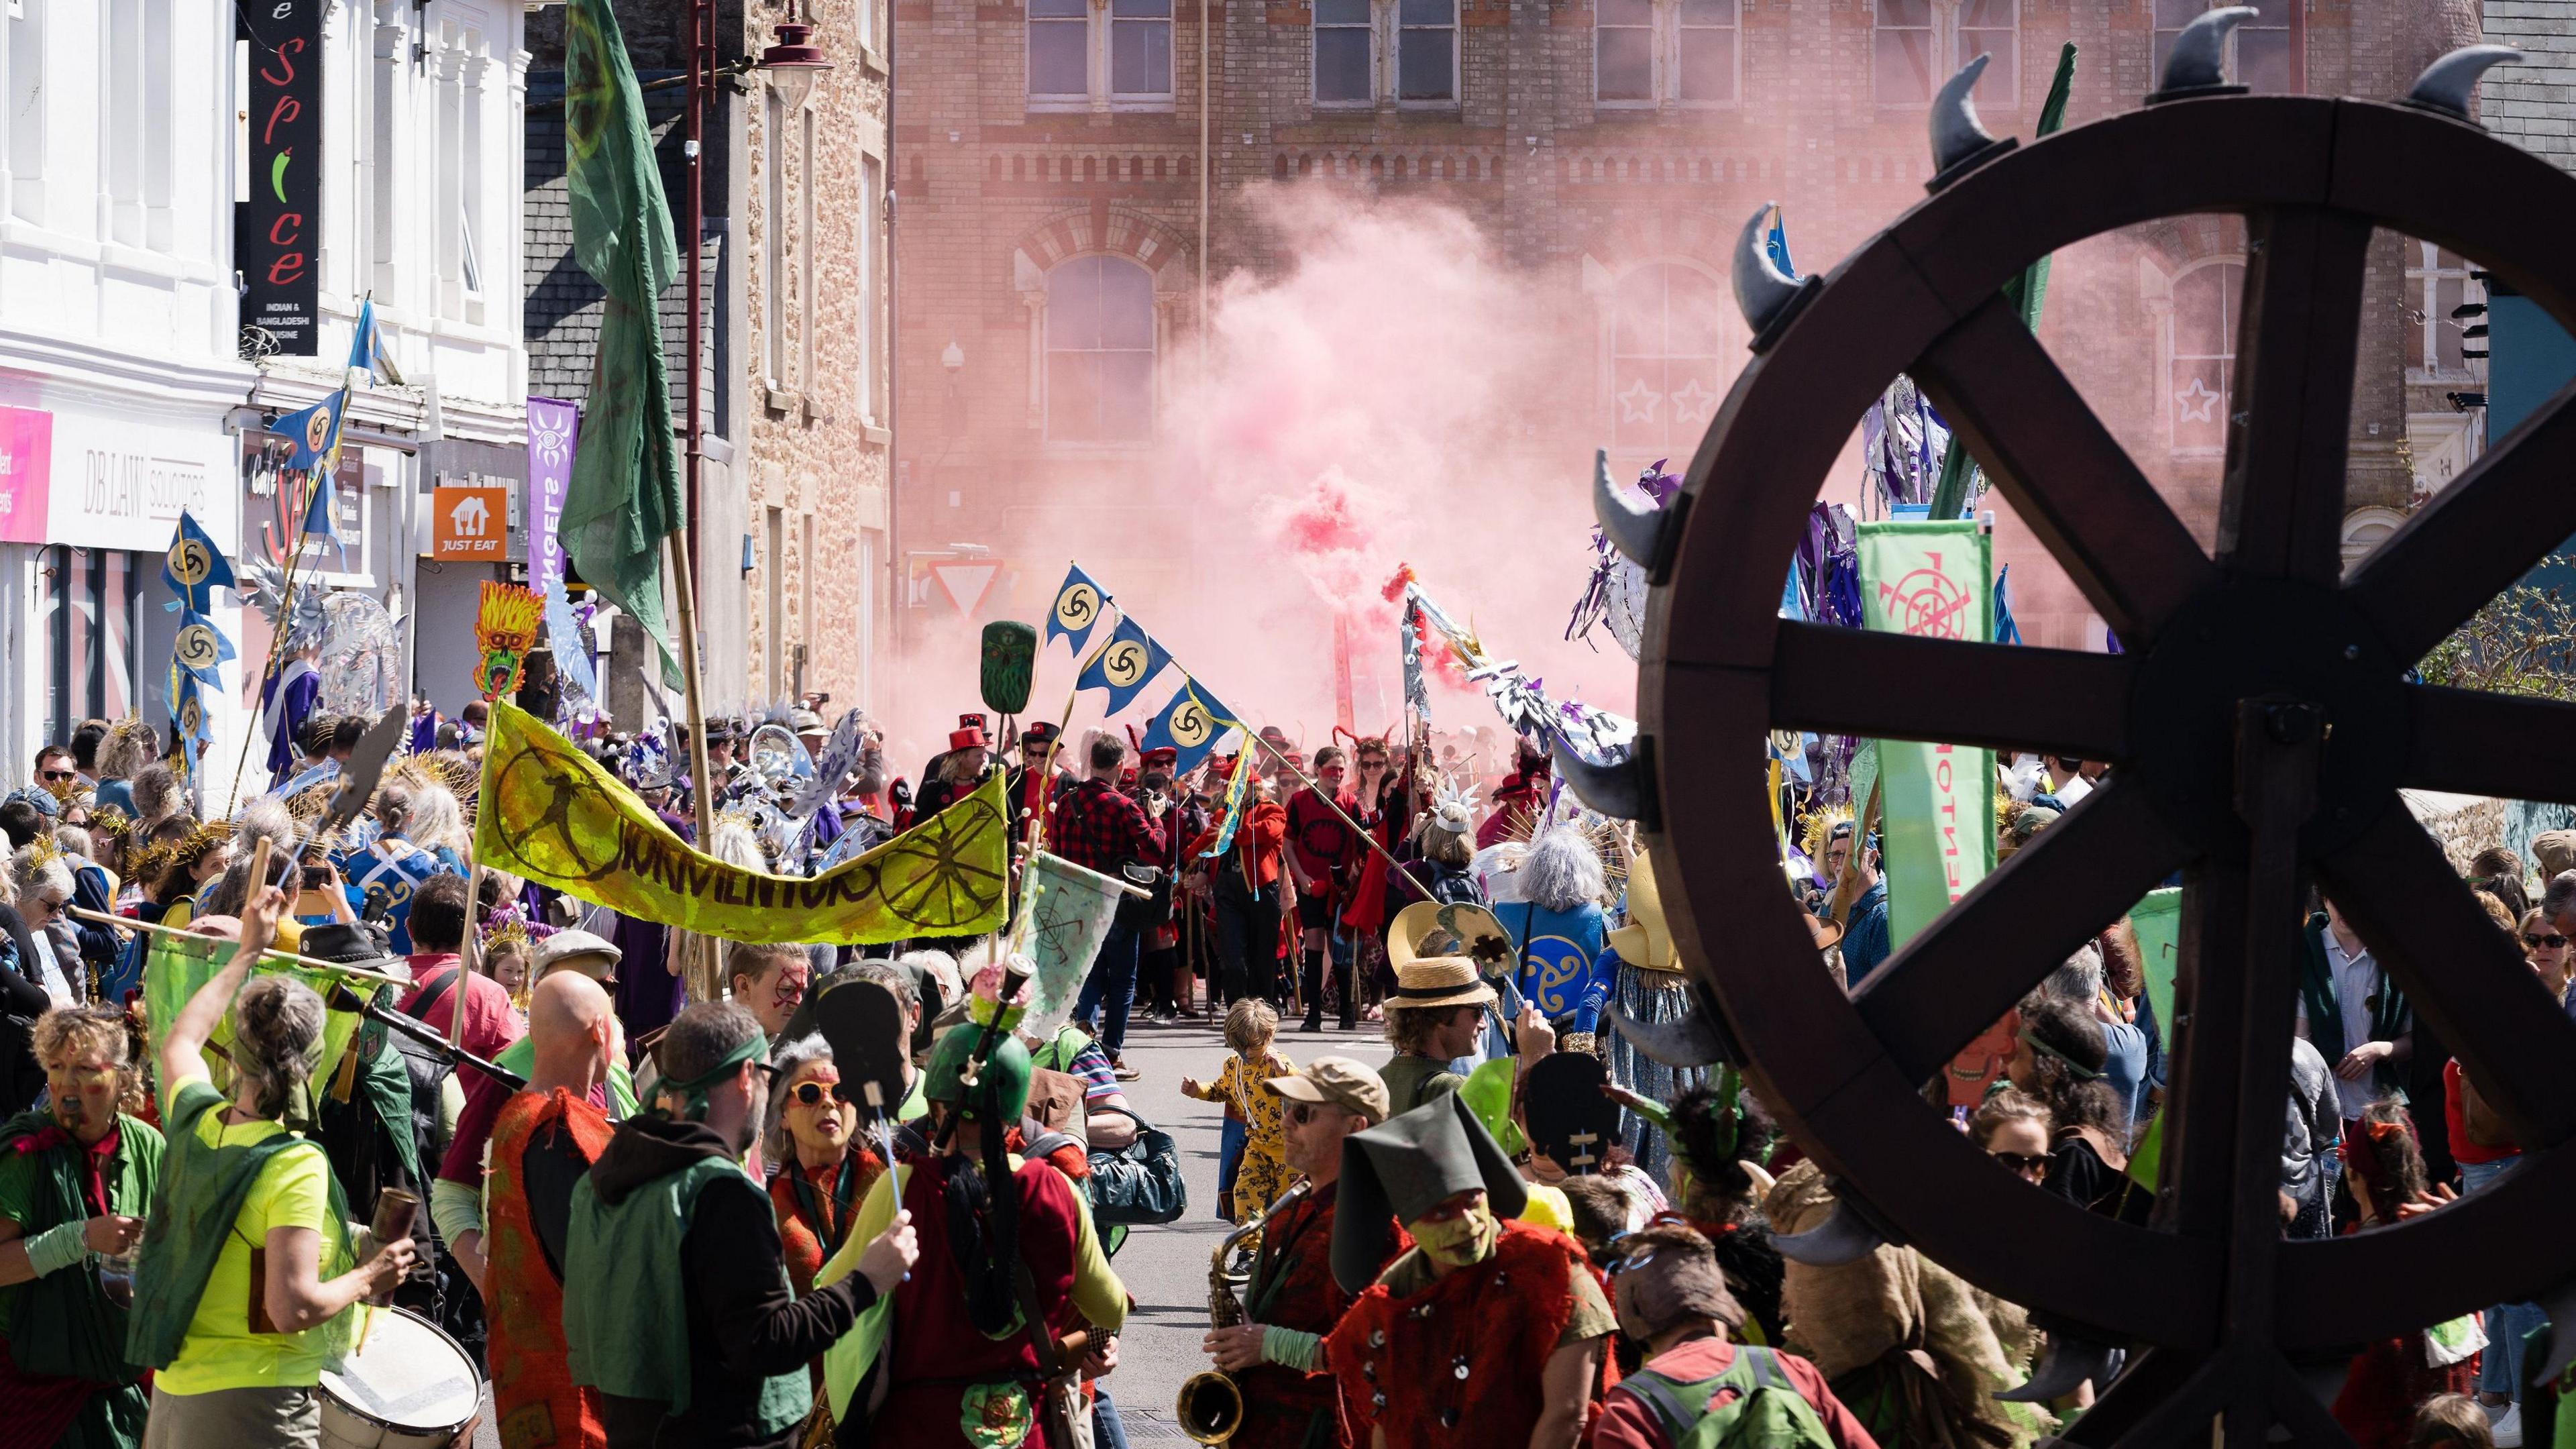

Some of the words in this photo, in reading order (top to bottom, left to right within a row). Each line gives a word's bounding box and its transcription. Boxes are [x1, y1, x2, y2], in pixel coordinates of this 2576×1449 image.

[266, 303, 292, 311] INDIAN
[293, 303, 300, 311] &
[256, 317, 310, 325] BANGLADESHI
[268, 331, 298, 339] UISINE
[84, 449, 107, 515] DB
[109, 452, 144, 518] LAW
[442, 539, 472, 552] JUST
[474, 539, 498, 551] EAT
